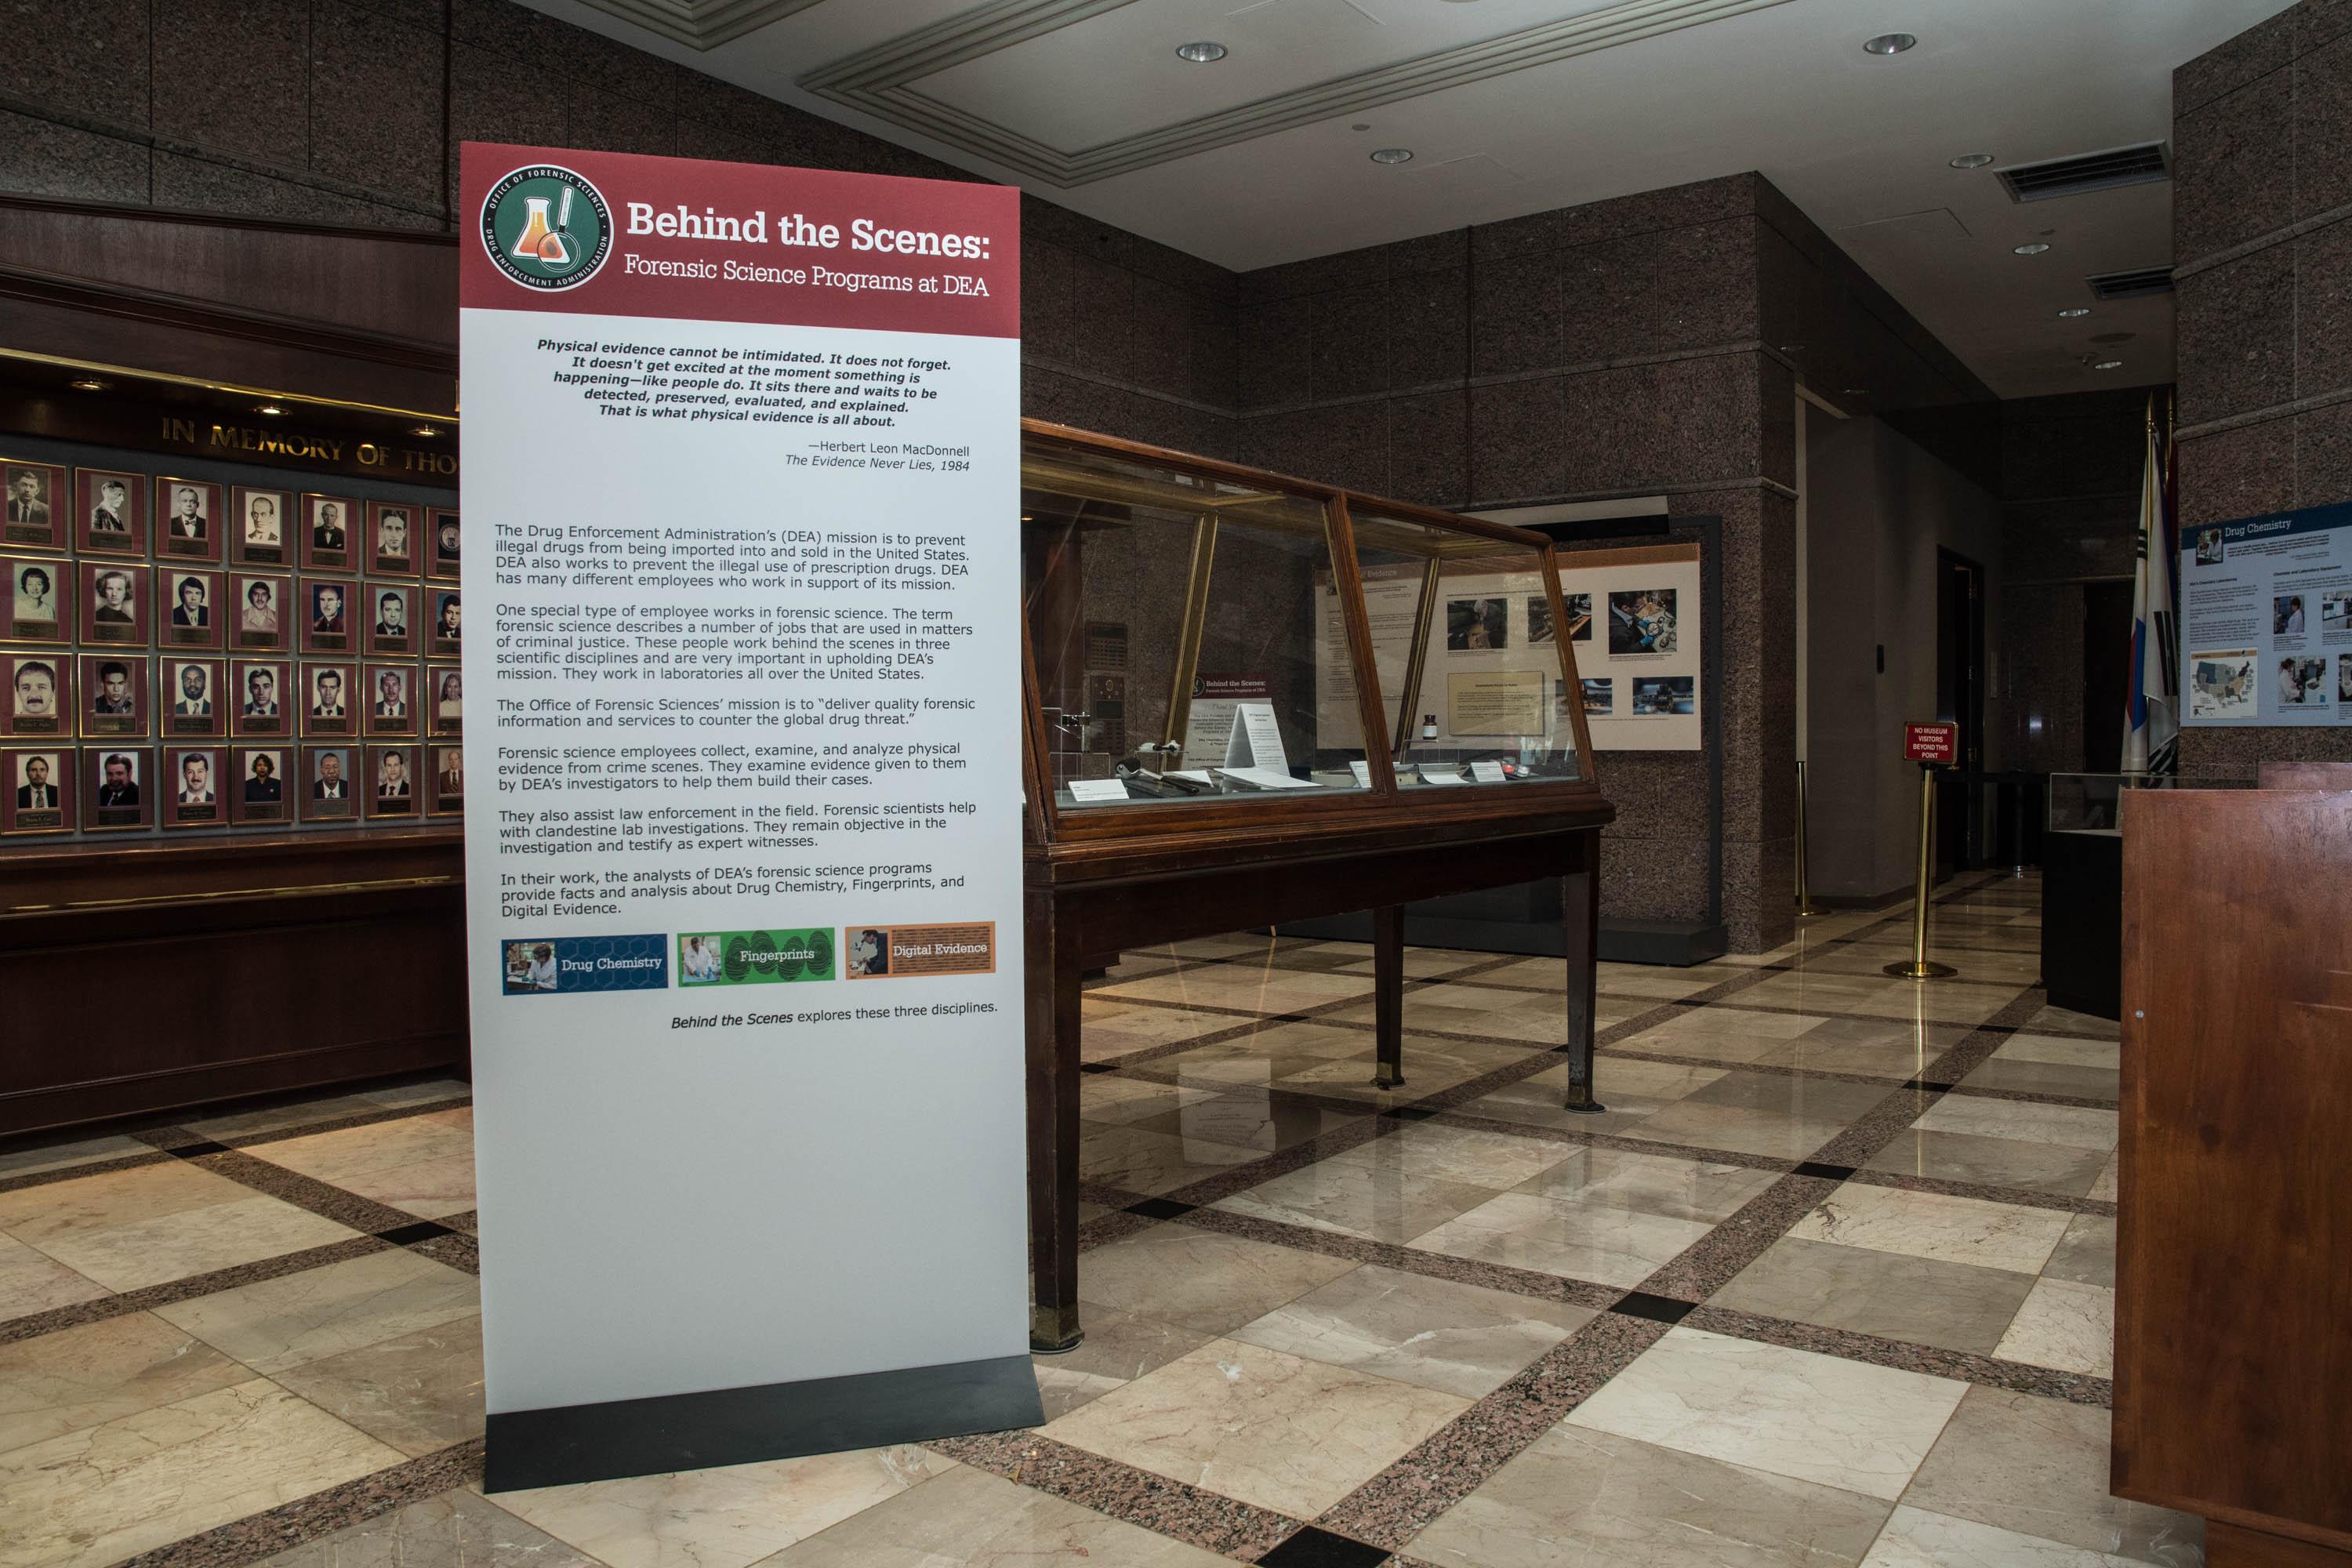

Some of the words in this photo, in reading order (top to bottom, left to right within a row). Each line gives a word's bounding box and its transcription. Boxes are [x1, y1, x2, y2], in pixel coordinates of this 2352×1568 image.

[489, 182, 511, 209] OFFICE
[513, 173, 524, 183] OF
[528, 169, 575, 183] FORENSIC
[577, 181, 606, 218] SCIENCES
[626, 201, 768, 244] Behind
[777, 213, 840, 249] the
[851, 218, 989, 260] Scenes:
[486, 229, 498, 252] DRUG
[495, 253, 552, 287] ENFORCEMENT
[557, 236, 608, 286] ADMINISTRATION
[624, 253, 717, 279] Forensic
[723, 260, 807, 285] Science
[811, 265, 913, 292] Programs
[918, 275, 938, 294] at
[942, 274, 990, 297] DEA
[537, 339, 598, 354] Physical
[601, 342, 666, 356] evidence
[669, 347, 719, 358] cannot
[720, 347, 739, 360] be
[742, 348, 825, 364] intimidated.
[829, 354, 843, 365] It
[845, 354, 878, 367] does
[880, 358, 905, 368] not
[907, 358, 951, 372] forget.
[572, 356, 586, 368] It
[646, 361, 671, 373] get
[673, 361, 726, 374] excited
[728, 364, 745, 375] at
[747, 364, 771, 376] the
[774, 368, 832, 379] moment
[833, 370, 906, 386] something
[909, 372, 921, 383] is
[671, 377, 720, 391] people
[723, 378, 745, 390] do.
[748, 379, 763, 391] It
[764, 380, 791, 393] sits
[794, 382, 831, 394] there
[833, 384, 861, 396] and
[864, 386, 900, 397] waits
[903, 387, 917, 398] to
[920, 387, 938, 400] be
[583, 387, 651, 404] detected,
[655, 393, 730, 407] preserved,
[734, 395, 806, 411] evaluated,
[810, 398, 837, 410] and
[840, 400, 909, 413] explained.
[599, 404, 632, 417] That
[635, 405, 648, 417] is
[652, 406, 688, 419] what
[690, 408, 750, 423] physical
[752, 411, 814, 424] evidence
[817, 412, 829, 425] is
[832, 414, 851, 425] all
[852, 415, 895, 427] about.
[162, 417, 194, 443] IN
[210, 425, 345, 461] MEMORY
[357, 444, 390, 466] OF
[870, 442, 898, 454] Leon
[902, 443, 970, 457] MacDonnell
[786, 454, 808, 466] The
[811, 455, 866, 468] Evidence
[869, 457, 906, 470] Never
[909, 459, 935, 473] Lies,
[940, 460, 970, 471] 1984
[2225, 526, 2245, 537] Drug
[2247, 520, 2292, 534] Chemistry
[495, 539, 538, 556] illegal
[543, 540, 584, 557] drugs
[589, 541, 622, 554] from
[628, 542, 666, 557] being
[672, 543, 735, 558] imported
[740, 545, 766, 557] into
[771, 545, 796, 557] and
[800, 546, 828, 558] sold
[833, 546, 845, 558] in
[849, 546, 872, 559] the
[877, 547, 919, 560] United
[924, 548, 970, 561] States.
[495, 571, 522, 584] has
[527, 575, 568, 588] many
[572, 572, 634, 586] different
[637, 574, 714, 590] employees
[718, 575, 747, 587] who
[752, 575, 786, 588] work
[790, 576, 803, 588] in
[807, 578, 859, 591] support
[863, 577, 877, 590] of
[881, 577, 897, 590] its
[902, 578, 955, 590] mission.
[496, 635, 512, 648] of
[515, 635, 573, 648] criminal
[577, 636, 630, 651] justice.
[634, 636, 677, 648] These
[682, 636, 728, 652] people
[733, 637, 768, 649] work
[771, 637, 818, 649] behind
[822, 637, 844, 650] the
[849, 640, 895, 650] scenes
[899, 637, 911, 650] in
[915, 637, 950, 650] three
[497, 667, 557, 680] mission.
[561, 667, 598, 682] They
[603, 667, 638, 680] work
[643, 667, 655, 680] in
[660, 667, 743, 680] laboratories
[747, 667, 764, 680] all
[768, 670, 800, 680] over
[802, 667, 826, 680] the
[829, 667, 873, 680] United
[878, 667, 924, 680] States.
[498, 746, 559, 759] Forensic
[563, 746, 616, 759] science
[620, 745, 697, 760] employees
[701, 744, 750, 759] collect,
[754, 743, 818, 758] examine,
[822, 743, 848, 756] and
[852, 742, 903, 757] analyze
[908, 742, 960, 757] physical
[500, 840, 593, 856] investigation
[597, 839, 624, 852] and
[628, 837, 673, 853] testify
[677, 840, 694, 850] as
[698, 837, 743, 851] expert
[747, 836, 818, 848] witnesses.
[740, 948, 815, 964] Fingerprints
[893, 943, 932, 957] Digital
[934, 941, 988, 954] Evidence
[561, 959, 593, 973] Drug
[597, 956, 662, 970] Chemistry
[671, 1014, 718, 1029] Behind
[721, 1014, 743, 1027] the
[746, 1013, 794, 1025] Scenes
[797, 1009, 852, 1025] explores
[855, 1007, 891, 1020] these
[894, 1005, 927, 1018] three
[931, 1001, 998, 1017] disciplines.
